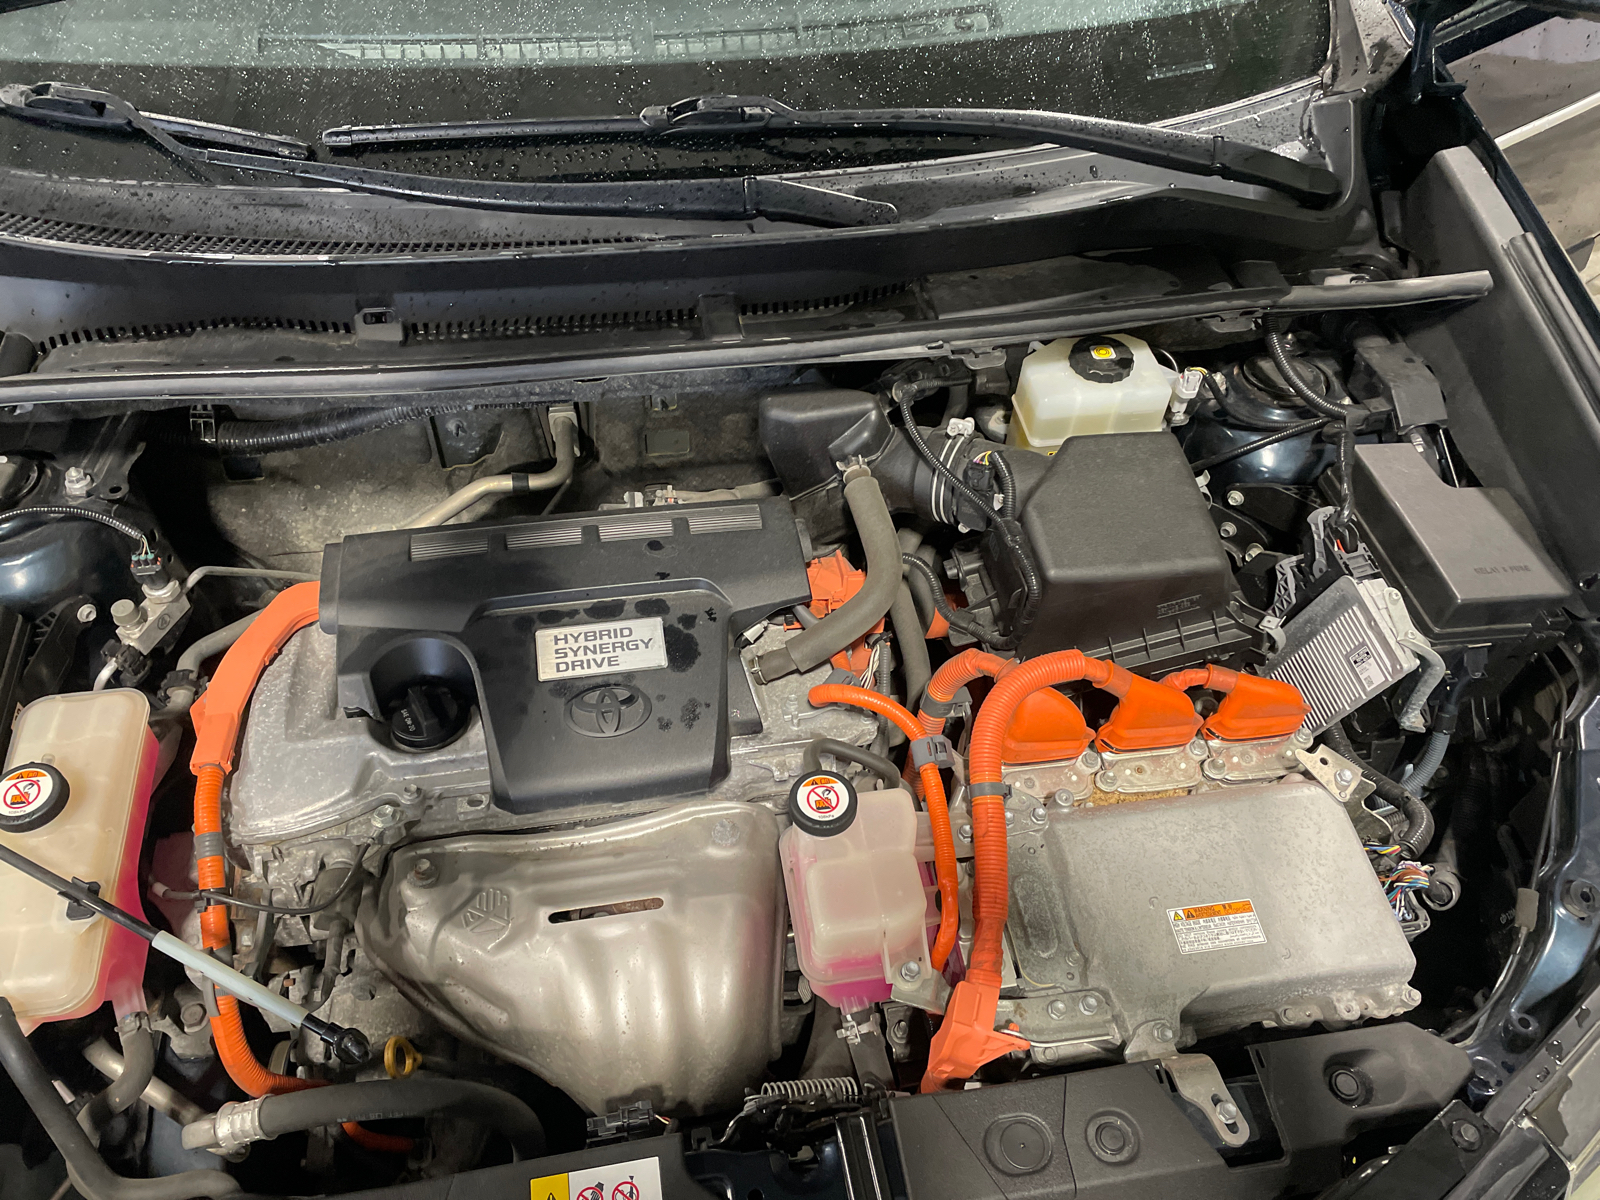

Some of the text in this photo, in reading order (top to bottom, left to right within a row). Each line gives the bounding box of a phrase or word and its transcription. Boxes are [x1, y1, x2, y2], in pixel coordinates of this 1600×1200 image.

[553, 627, 633, 646] HYBRID
[555, 638, 653, 660] SYNERGY
[555, 656, 620, 673] DRIVE
[400, 708, 410, 718] SAE
